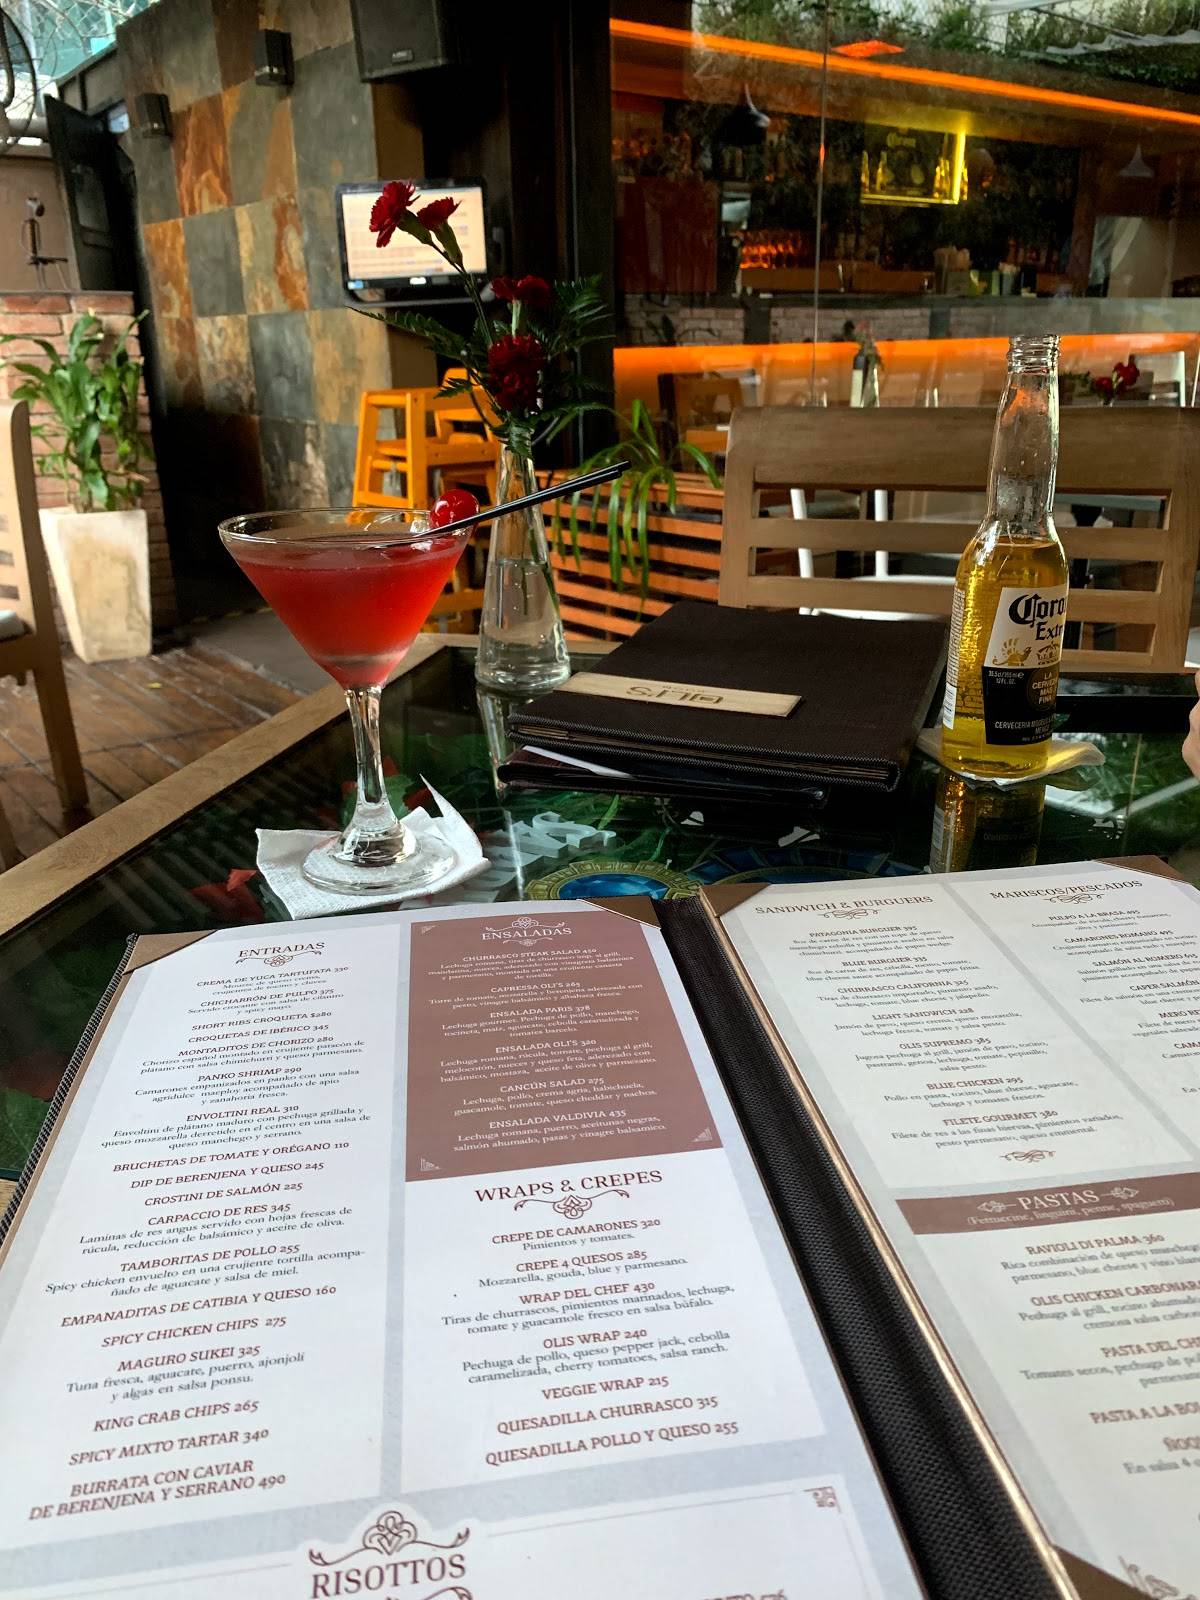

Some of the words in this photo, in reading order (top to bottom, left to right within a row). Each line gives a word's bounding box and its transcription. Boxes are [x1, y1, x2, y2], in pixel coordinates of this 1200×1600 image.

[1009, 594, 1066, 628] Coro
[989, 880, 1142, 898] MARISCOS/PESCADOS
[755, 902, 839, 913] SANDWICH
[852, 896, 933, 909] BURGUERS
[482, 928, 572, 940] ENSALADAS
[238, 942, 325, 958] ENTRADAS
[200, 994, 267, 1006] CHICHARRÓN
[285, 989, 318, 998] PULPO
[320, 988, 334, 996] 375
[178, 1043, 248, 1056] MONTADITOS
[267, 1037, 314, 1047] CHORIZO
[499, 1081, 546, 1092] CANCÚN
[549, 1078, 585, 1087] SALAD
[587, 1077, 605, 1086] 275
[186, 1110, 247, 1121] ENVOLTINI
[250, 1106, 280, 1115] REAL
[282, 1105, 299, 1114] 310
[488, 1116, 550, 1128] ENSALADA
[552, 1110, 606, 1121] VALDIVIA
[608, 1109, 626, 1117] 435
[941, 1116, 982, 1126] FILETE
[981, 1111, 1037, 1122] GOURMET
[1039, 1109, 1058, 1119] 380
[113, 1157, 186, 1172] BRUCHETAS
[189, 1155, 206, 1163] DE
[209, 1149, 259, 1161] TOMATE
[272, 1142, 330, 1154] ORÉGANO
[130, 1179, 152, 1188] DIP
[155, 1177, 173, 1185] DE
[175, 1168, 246, 1183] BERENJENA
[251, 1167, 256, 1175] Y
[260, 1162, 302, 1174] QUESO
[304, 1162, 324, 1170] 245
[475, 1181, 553, 1201] WRAPS
[560, 1179, 573, 1192] &
[580, 1170, 662, 1189] CREPES
[144, 1192, 203, 1206] CROSTINI
[205, 1189, 223, 1199] DE
[225, 1183, 280, 1196] SALMÓN
[283, 1182, 303, 1191] 225
[1018, 1190, 1099, 1209] PASTAS
[147, 1209, 220, 1225] CARPACCIO
[223, 1207, 241, 1216] DE
[243, 1204, 268, 1214] RES
[270, 1203, 291, 1213] 345
[491, 1231, 533, 1244] CREPE
[535, 1229, 554, 1239] DE
[556, 1219, 638, 1236] CAMARONES
[640, 1218, 660, 1229] 320
[522, 1239, 577, 1250] Pimientos
[589, 1233, 634, 1242] tomates.
[120, 1252, 209, 1271] TAMBORITAS
[212, 1250, 231, 1260] DE
[233, 1244, 276, 1258] POLLO
[279, 1244, 300, 1254] 255
[515, 1259, 558, 1272] CREPE
[561, 1260, 569, 1268] 4
[571, 1251, 623, 1267] QUESOS
[626, 1249, 647, 1260] 285
[478, 1272, 543, 1287] Mozzarella,
[546, 1268, 585, 1282] gouda,
[587, 1265, 611, 1274] blue
[624, 1258, 687, 1273] parmesano.
[518, 1291, 560, 1304] WRAP
[563, 1287, 591, 1299] DEL
[593, 1283, 627, 1295] CHEF
[633, 1282, 655, 1293] 430
[60, 1304, 166, 1327] EMPANADITAS
[169, 1301, 189, 1312] DE
[192, 1294, 247, 1310] CATIBIA
[253, 1292, 259, 1302] Y
[263, 1287, 311, 1302] QUESO
[316, 1285, 336, 1295] 160
[101, 1332, 142, 1347] SPICY
[146, 1323, 212, 1341] CHICKEN
[216, 1318, 258, 1332] CHIPS
[265, 1316, 286, 1327] 275
[542, 1335, 574, 1348] OLIS
[577, 1329, 620, 1344] WRAP
[623, 1329, 647, 1339] 240
[117, 1352, 186, 1371] MAGURO
[189, 1346, 234, 1362] SUKEI
[237, 1345, 260, 1358] 325
[66, 1381, 98, 1392] Tuna
[103, 1376, 143, 1387] fresca,
[147, 1367, 204, 1383] aguacate,
[208, 1361, 254, 1376] puerro,
[258, 1351, 304, 1368] ajonjolí
[122, 1388, 153, 1400] algas
[157, 1385, 173, 1394] en
[177, 1380, 206, 1391] salsa
[210, 1375, 253, 1390] ponsu.
[541, 1382, 597, 1399] VEGGIE
[599, 1377, 644, 1392] WRAP
[647, 1375, 669, 1387] 215
[93, 1415, 134, 1432] KING
[137, 1409, 180, 1425] CRAB
[183, 1403, 230, 1418] CHIPS
[233, 1400, 259, 1412] 265
[496, 1409, 596, 1435] QUESADILLA
[599, 1397, 693, 1419] CHURRASCO
[696, 1395, 718, 1409] 315
[68, 1448, 113, 1465] SPICY
[118, 1440, 174, 1458] MIXTO
[178, 1431, 238, 1449] TARTAR
[243, 1428, 268, 1444] 340
[484, 1439, 588, 1466] QUESADILLA
[590, 1432, 641, 1449] POLLO
[646, 1430, 653, 1441] Y
[657, 1423, 711, 1441] QUESO
[714, 1421, 738, 1435] 255
[70, 1474, 149, 1497] BURRATA
[153, 1468, 189, 1485] CON
[192, 1459, 253, 1479] CAVIAR
[28, 1504, 53, 1520] DE
[56, 1490, 155, 1516] BERENJENA
[162, 1488, 170, 1500] Y
[174, 1476, 255, 1498] SERRANO
[257, 1474, 285, 1489] 490
[311, 1554, 466, 1599] RISOTTOS
